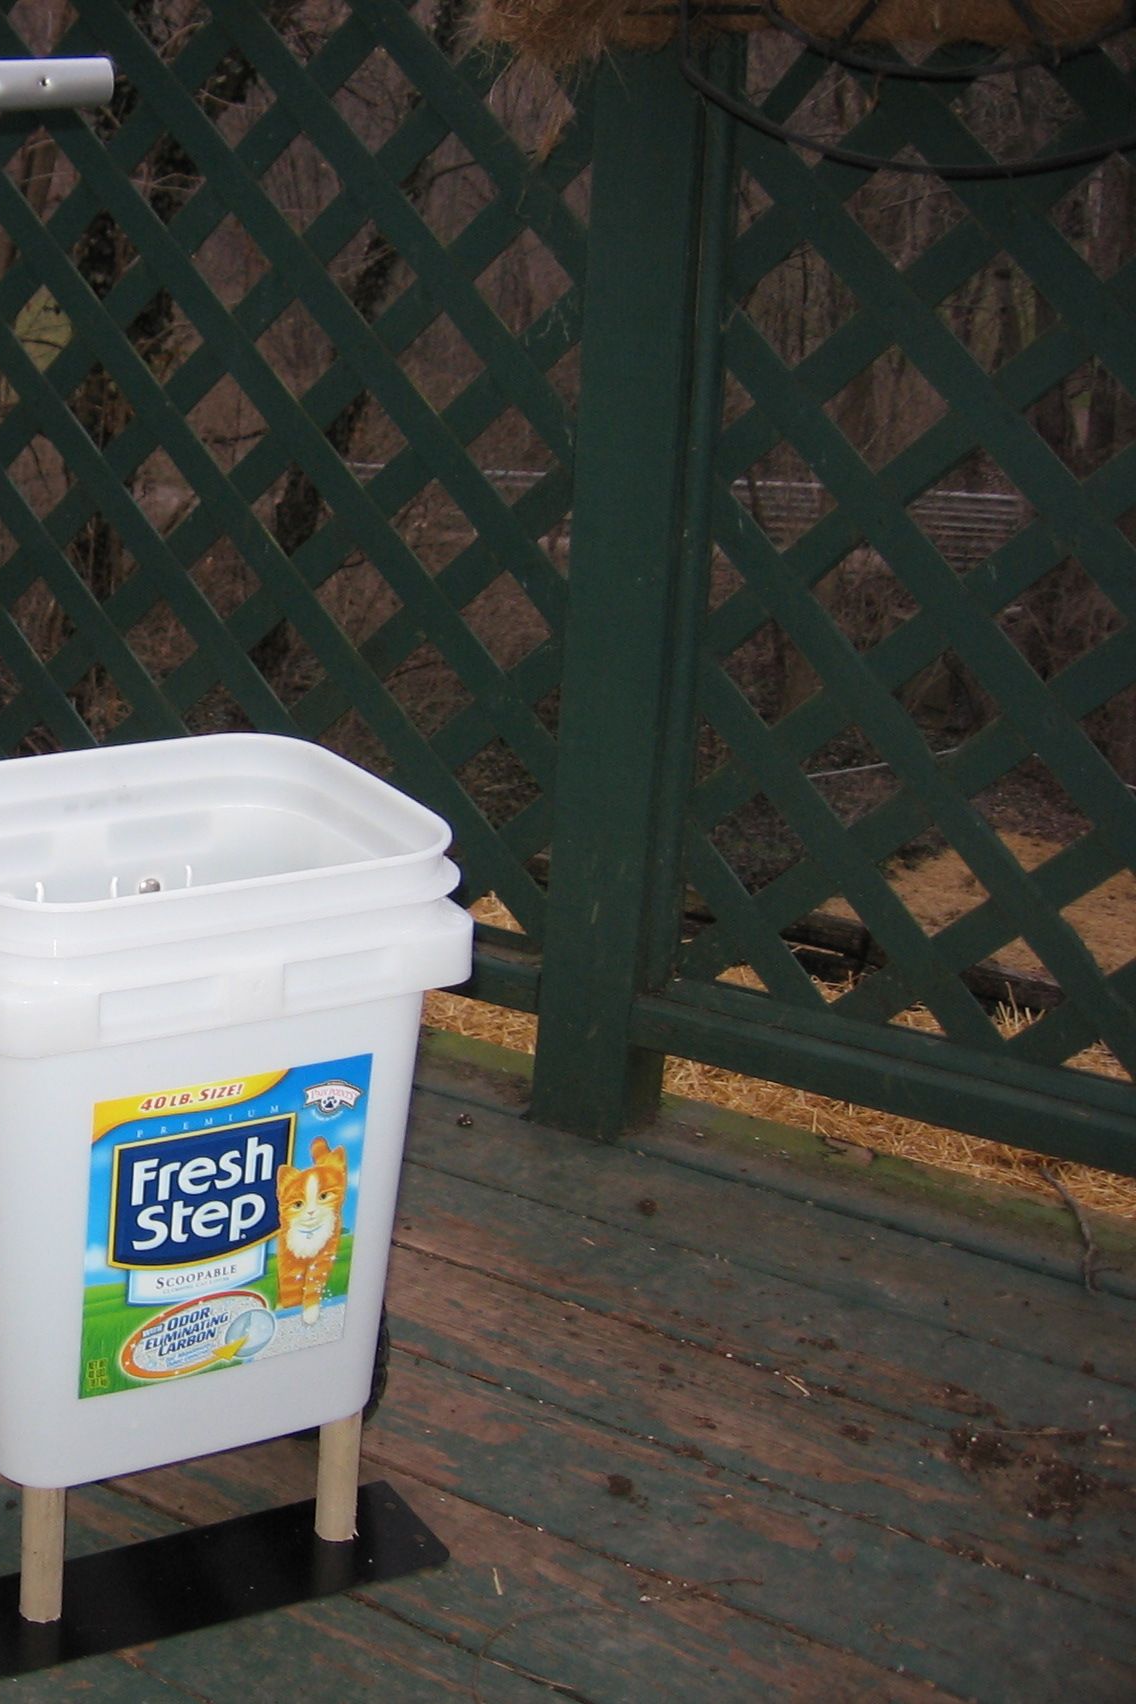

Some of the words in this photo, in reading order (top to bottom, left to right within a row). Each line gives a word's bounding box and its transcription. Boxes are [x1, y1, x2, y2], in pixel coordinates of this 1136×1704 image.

[140, 1096, 167, 1111] 40
[198, 1083, 243, 1102] SIZE!
[136, 1105, 279, 1138] PREMIUM
[131, 1136, 274, 1206] Fresh
[132, 1193, 266, 1251] Step
[155, 1264, 237, 1290] SCOOPABLE
[167, 1306, 211, 1331] ODOR
[158, 1327, 217, 1357] CARBON
